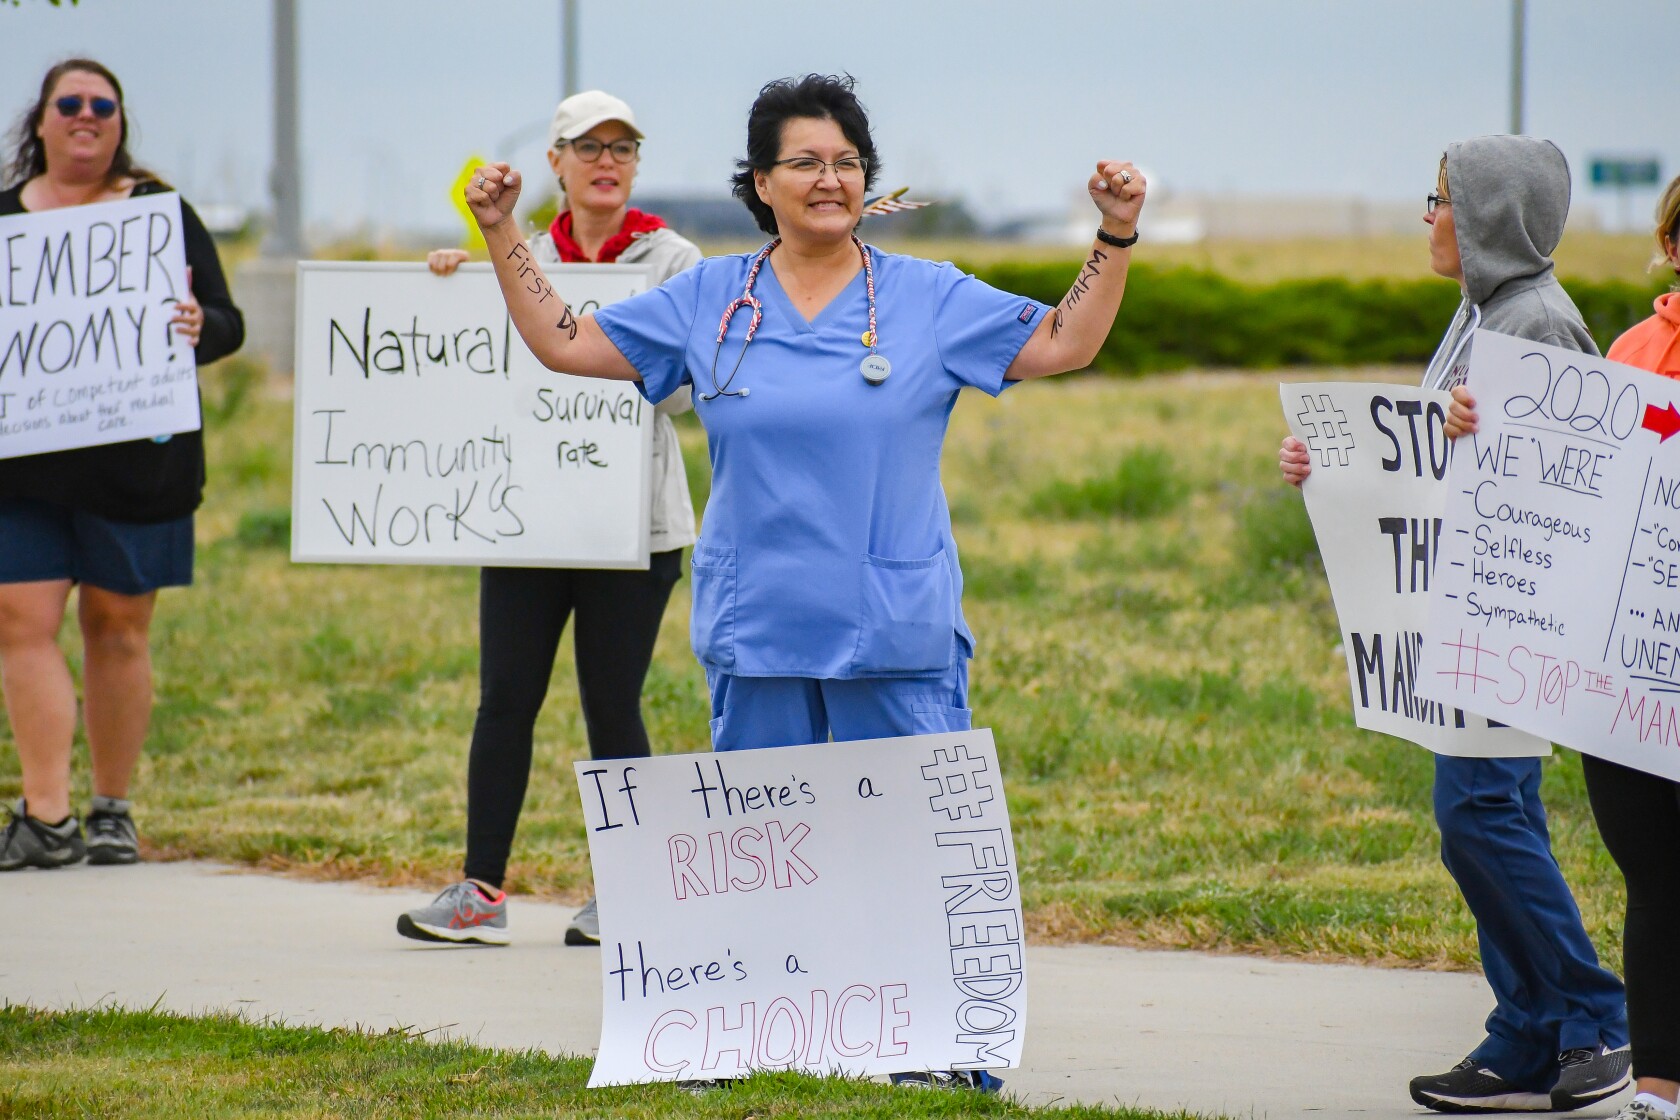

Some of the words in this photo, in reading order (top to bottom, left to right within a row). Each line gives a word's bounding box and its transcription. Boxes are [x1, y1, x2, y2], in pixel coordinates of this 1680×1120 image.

[0, 213, 175, 306] EMBER
[507, 243, 553, 303] First
[1066, 249, 1107, 310] HARM
[330, 307, 510, 380] Natural
[28, 389, 46, 410] of
[1504, 352, 1640, 441] 2020
[313, 410, 511, 487] Immunity
[557, 439, 608, 469] rate
[1370, 395, 1456, 481] STO
[1474, 433, 1523, 478] WE
[1585, 669, 1614, 691] THE
[582, 767, 639, 832] If
[692, 759, 816, 818] there's
[858, 776, 882, 798] a
[667, 820, 818, 900] RISK
[610, 941, 747, 1001] there's
[785, 954, 808, 974] a
[643, 984, 911, 1073] CHOICE
